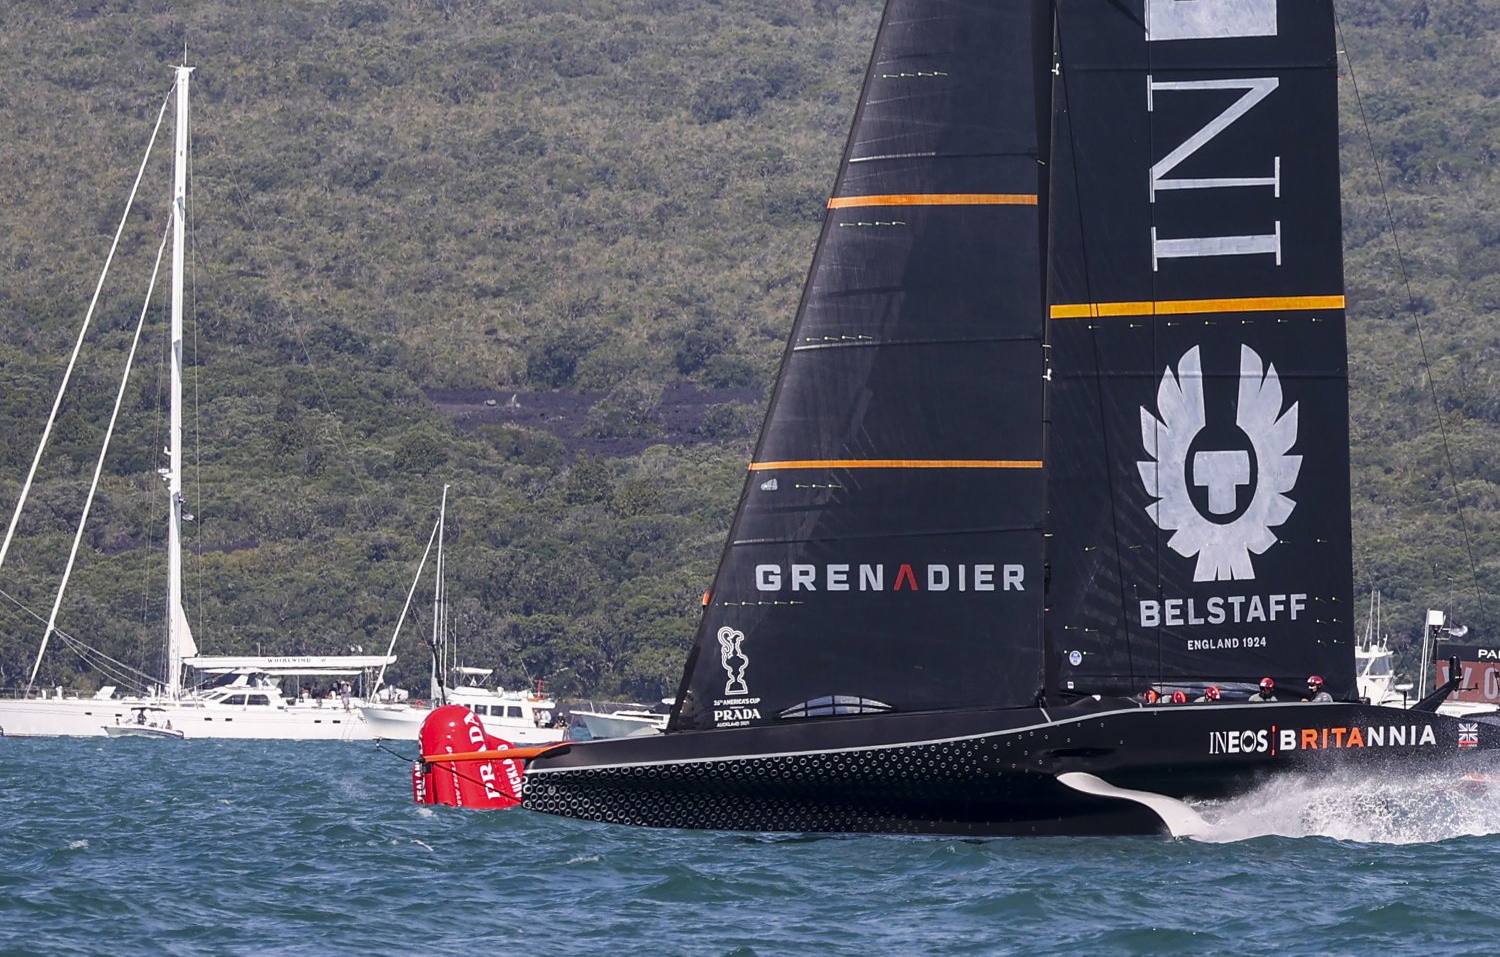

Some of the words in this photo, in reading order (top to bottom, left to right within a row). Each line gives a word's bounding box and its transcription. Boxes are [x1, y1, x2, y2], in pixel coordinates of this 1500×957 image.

[755, 563, 1025, 591] GRENADIER
[1139, 593, 1307, 627] BELSTAFF
[1187, 639, 1240, 650] ENGLAND
[1242, 637, 1267, 648] 1924
[713, 708, 761, 721] PRADA
[1209, 729, 1268, 754] INEOS
[1279, 725, 1437, 750] BRITANNIA
